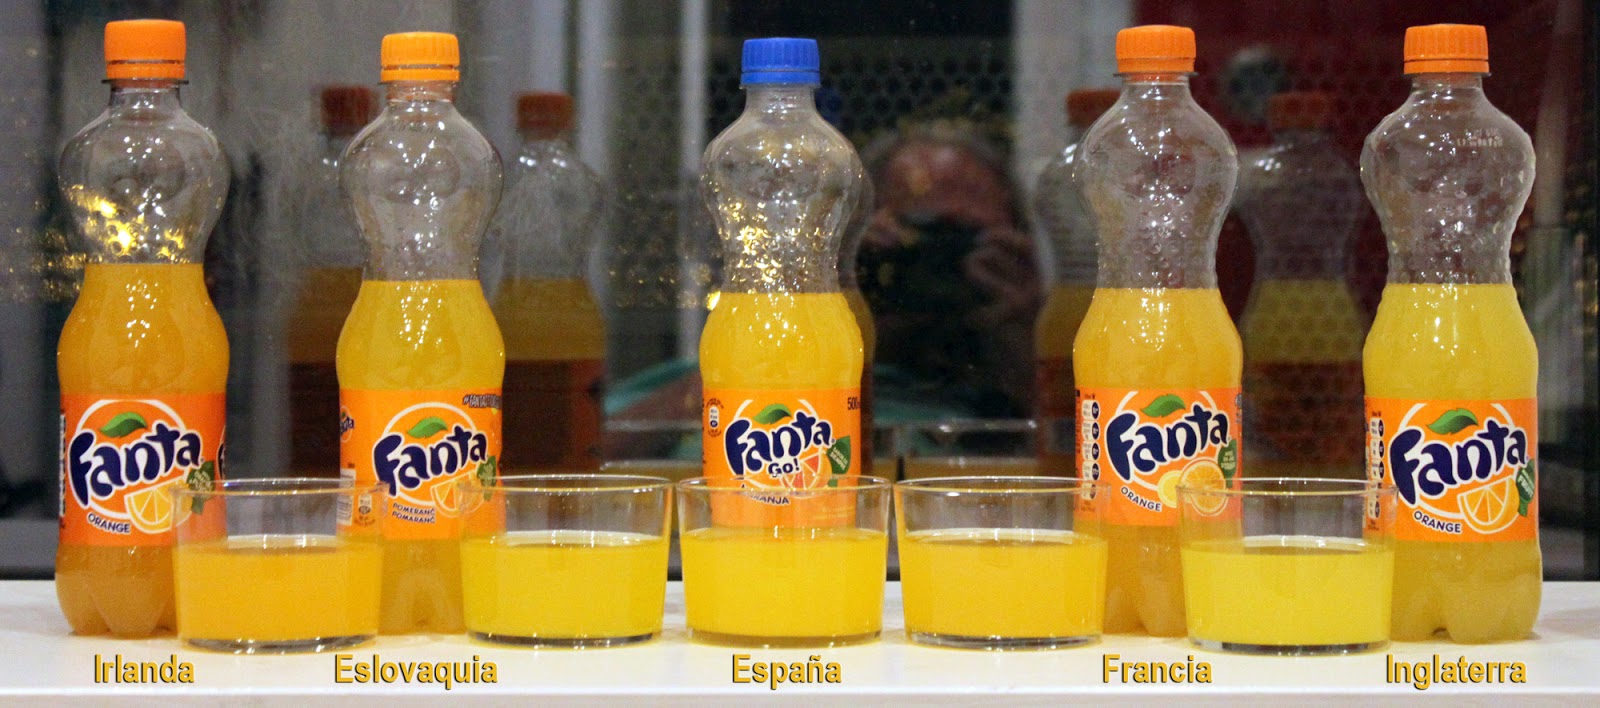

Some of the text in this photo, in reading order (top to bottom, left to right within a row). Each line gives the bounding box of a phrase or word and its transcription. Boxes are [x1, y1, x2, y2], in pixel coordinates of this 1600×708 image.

[69, 422, 202, 507] Fanta
[373, 425, 487, 497] Fanta
[724, 411, 832, 475] Fanta
[1107, 403, 1229, 480] Fanta
[1389, 419, 1527, 505] Fanta
[87, 513, 131, 534] ORANGE
[1120, 486, 1162, 512] ORANGE
[1413, 509, 1462, 533] ORANGE
